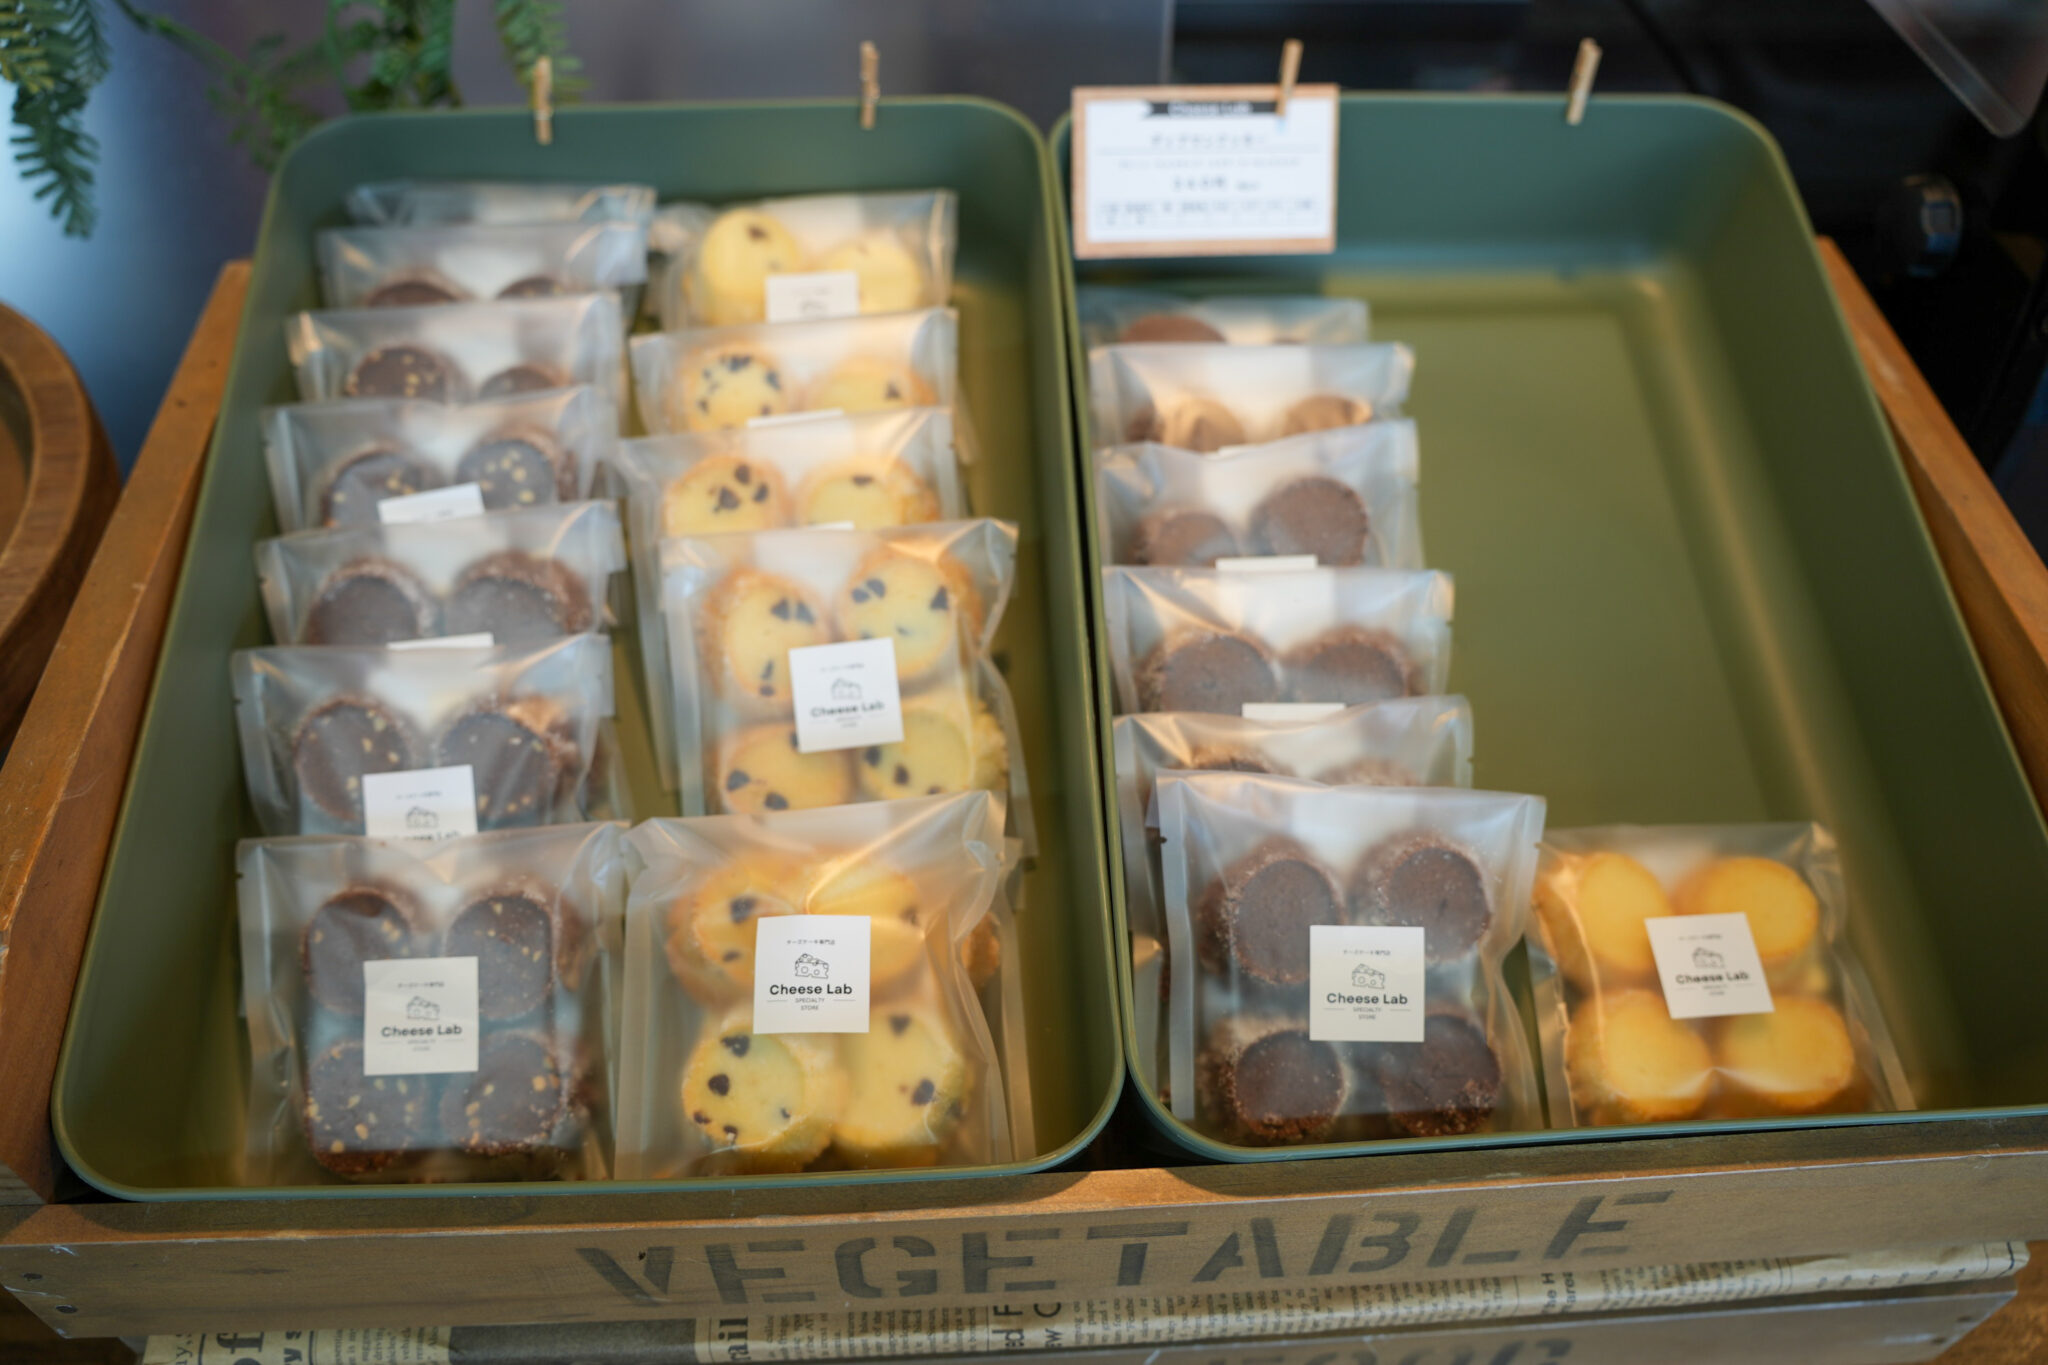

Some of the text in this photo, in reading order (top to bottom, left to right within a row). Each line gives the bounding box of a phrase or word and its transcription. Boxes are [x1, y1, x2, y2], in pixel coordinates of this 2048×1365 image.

[811, 700, 885, 718] Cheese Lab
[1675, 969, 1750, 985] Cheese Lab
[769, 983, 853, 996] Cheese Lab
[1326, 992, 1408, 1005] Cheese Lab
[381, 1023, 462, 1038] Cheese Lab
[576, 1190, 1674, 1306] VEGETABLE
